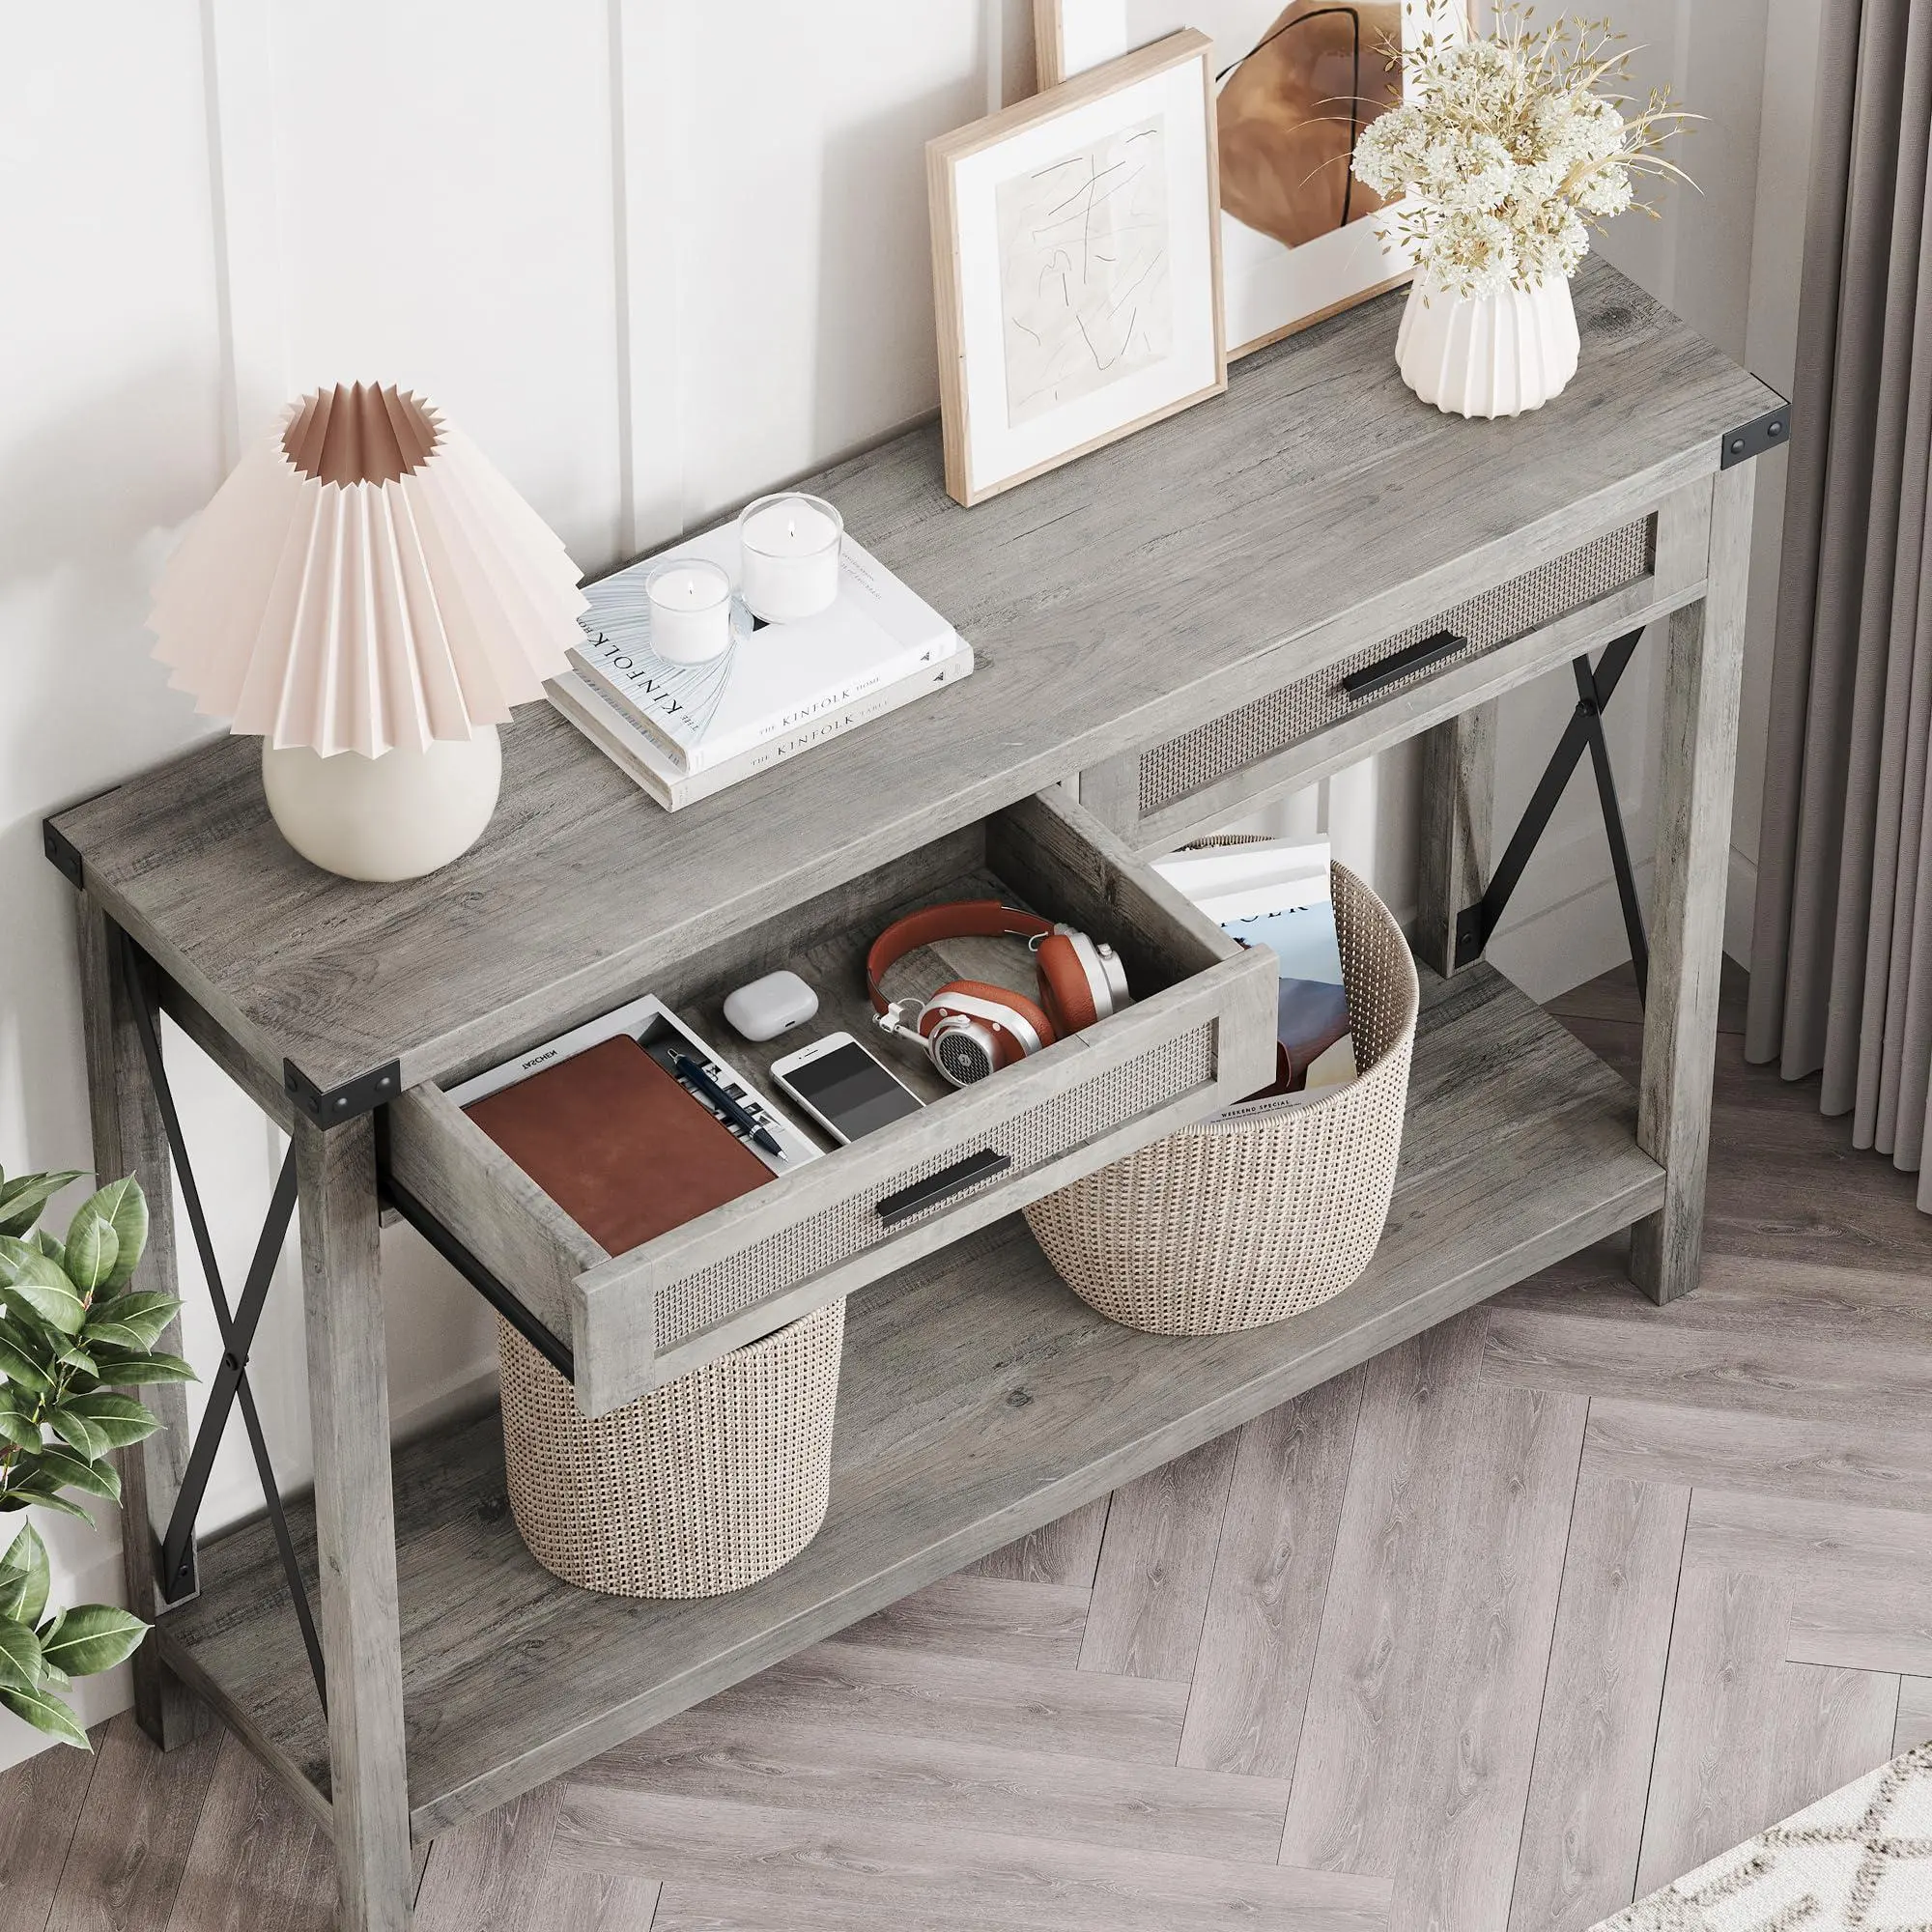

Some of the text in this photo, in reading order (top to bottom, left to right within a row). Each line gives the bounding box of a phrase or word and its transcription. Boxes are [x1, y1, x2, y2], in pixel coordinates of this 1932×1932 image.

[586, 632, 685, 716] KINFOLK
[680, 713, 700, 732] THE
[782, 688, 851, 726] KINFOLK
[778, 714, 854, 755] KINFOLK
[1221, 1106, 1257, 1118] WEEKEND
[1259, 1099, 1290, 1110] SPECIAL
